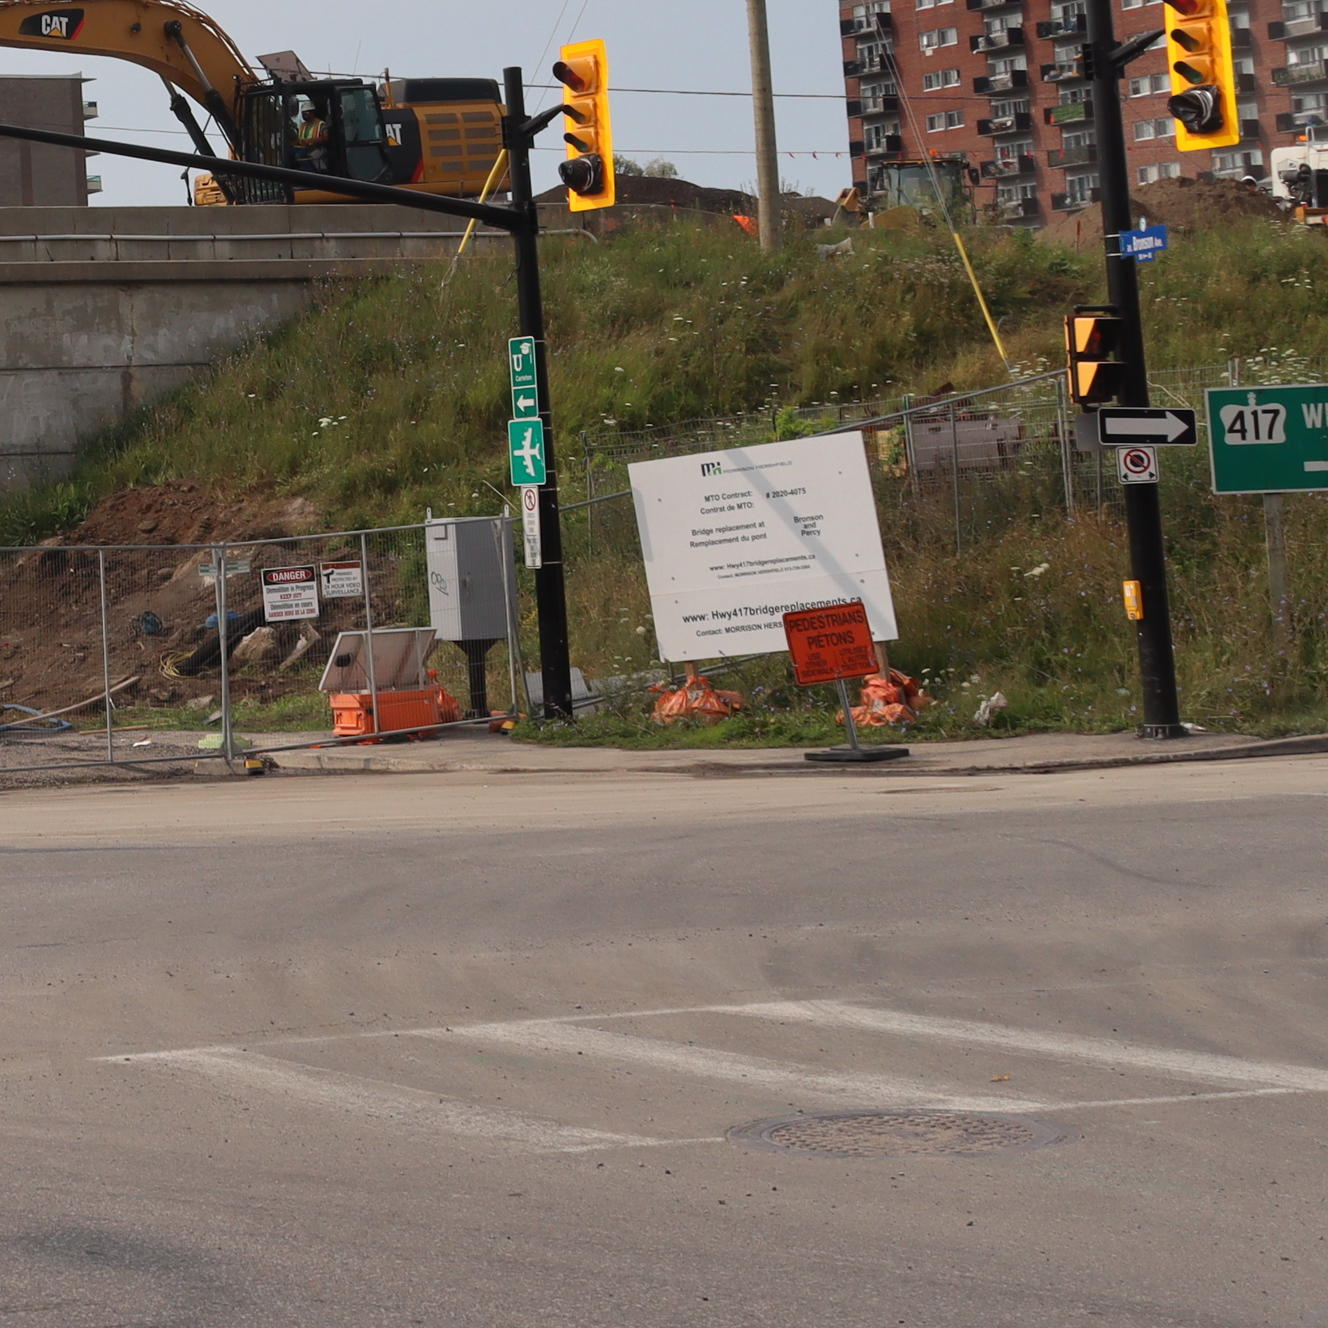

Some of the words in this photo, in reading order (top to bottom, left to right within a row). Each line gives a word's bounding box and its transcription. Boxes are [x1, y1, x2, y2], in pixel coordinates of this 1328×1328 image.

[41, 14, 69, 37] CAT
[385, 123, 402, 146] AT
[1226, 409, 1281, 441] 417
[1301, 402, 1328, 429] W
[704, 493, 720, 502] MTO
[721, 490, 752, 501] Contract:
[700, 506, 726, 515] Contrat
[794, 514, 824, 523] Bronson
[691, 526, 714, 536] Bridge
[715, 522, 757, 534] replacement
[801, 529, 821, 537] Percy
[689, 537, 740, 549] Remplacement
[751, 533, 767, 543] pont
[272, 570, 307, 582] DANGER
[682, 614, 710, 624] www:
[711, 596, 863, 621] Hwy417bridgereplacementsca
[696, 628, 722, 637] Contact:
[725, 624, 763, 634] MORRISON
[764, 621, 783, 631] HERS
[789, 610, 864, 632] PEDESTRIANS
